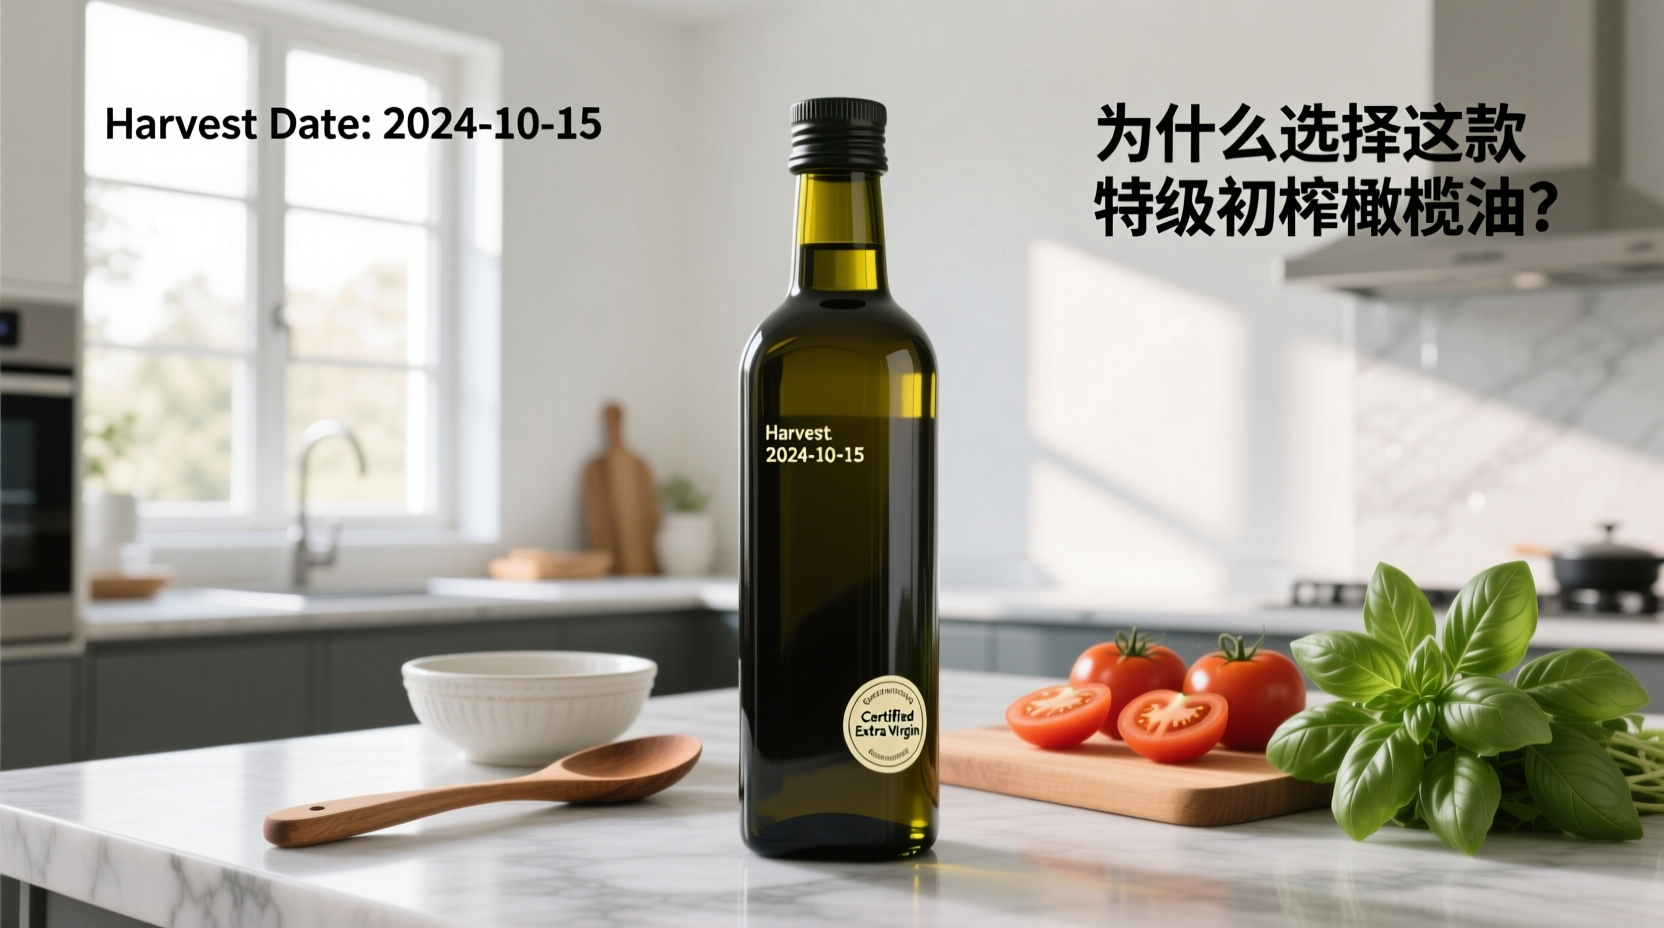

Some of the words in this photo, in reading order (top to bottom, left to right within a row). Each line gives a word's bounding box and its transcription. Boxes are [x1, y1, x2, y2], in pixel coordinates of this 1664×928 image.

[765, 424, 832, 441] Harvest
[765, 446, 865, 463] 2024-10-15
[861, 709, 914, 723] Certified
[855, 725, 887, 737] Extra
